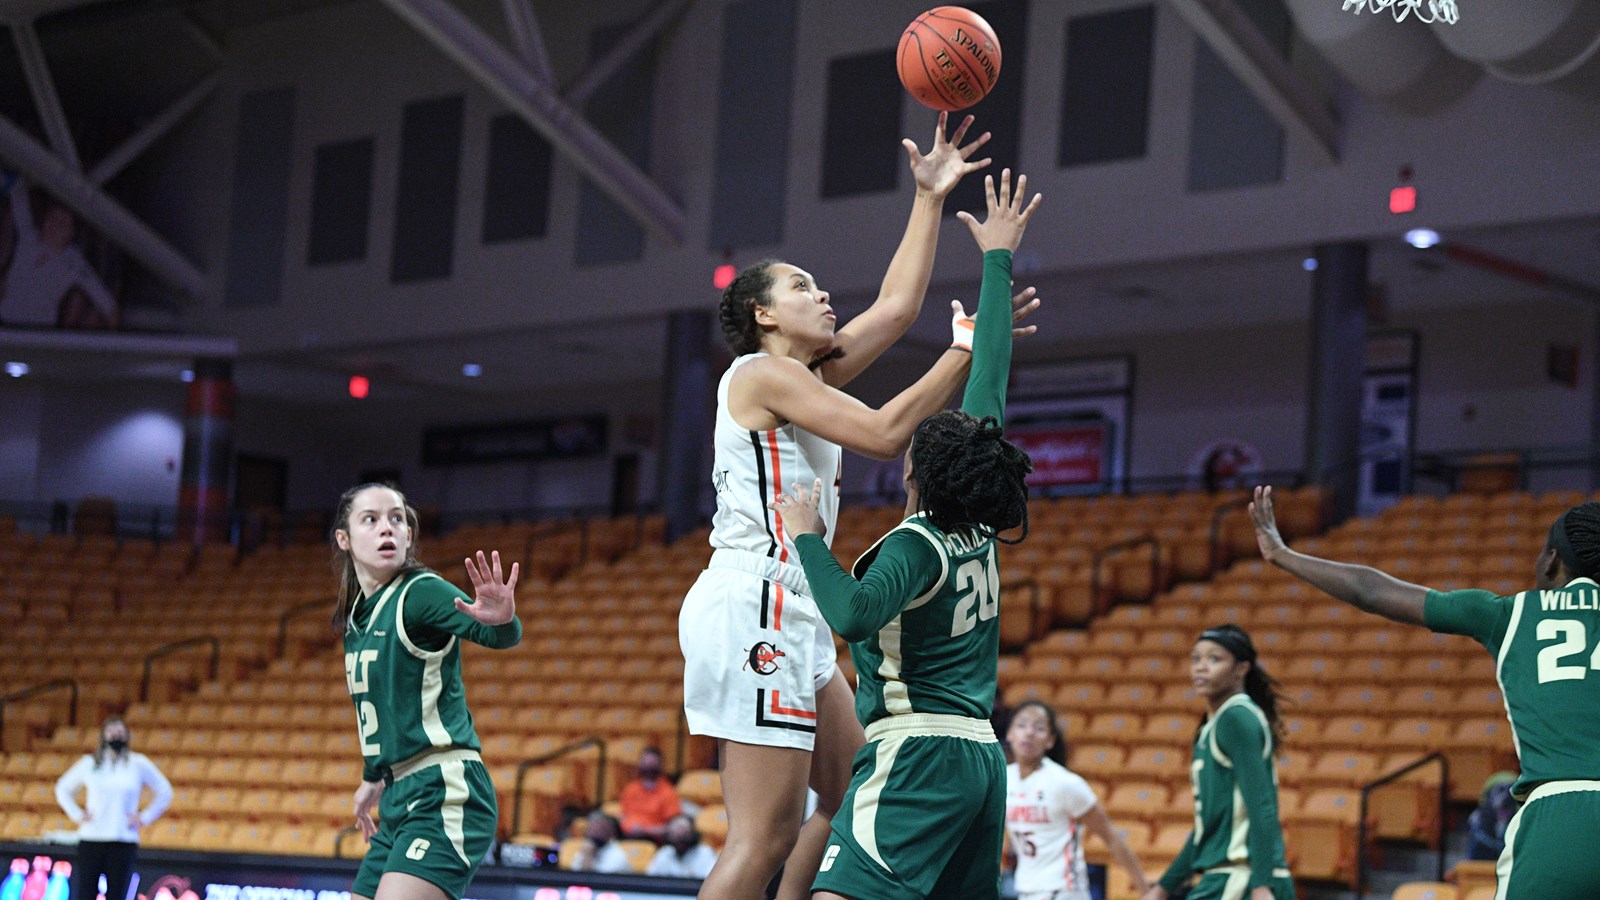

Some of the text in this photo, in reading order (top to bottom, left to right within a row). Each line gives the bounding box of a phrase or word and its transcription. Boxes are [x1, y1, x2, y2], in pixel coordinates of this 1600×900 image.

[949, 28, 998, 90] SPALDING
[950, 541, 1000, 637] 20
[1539, 588, 1600, 611] WILLI
[1536, 619, 1600, 684] 2
